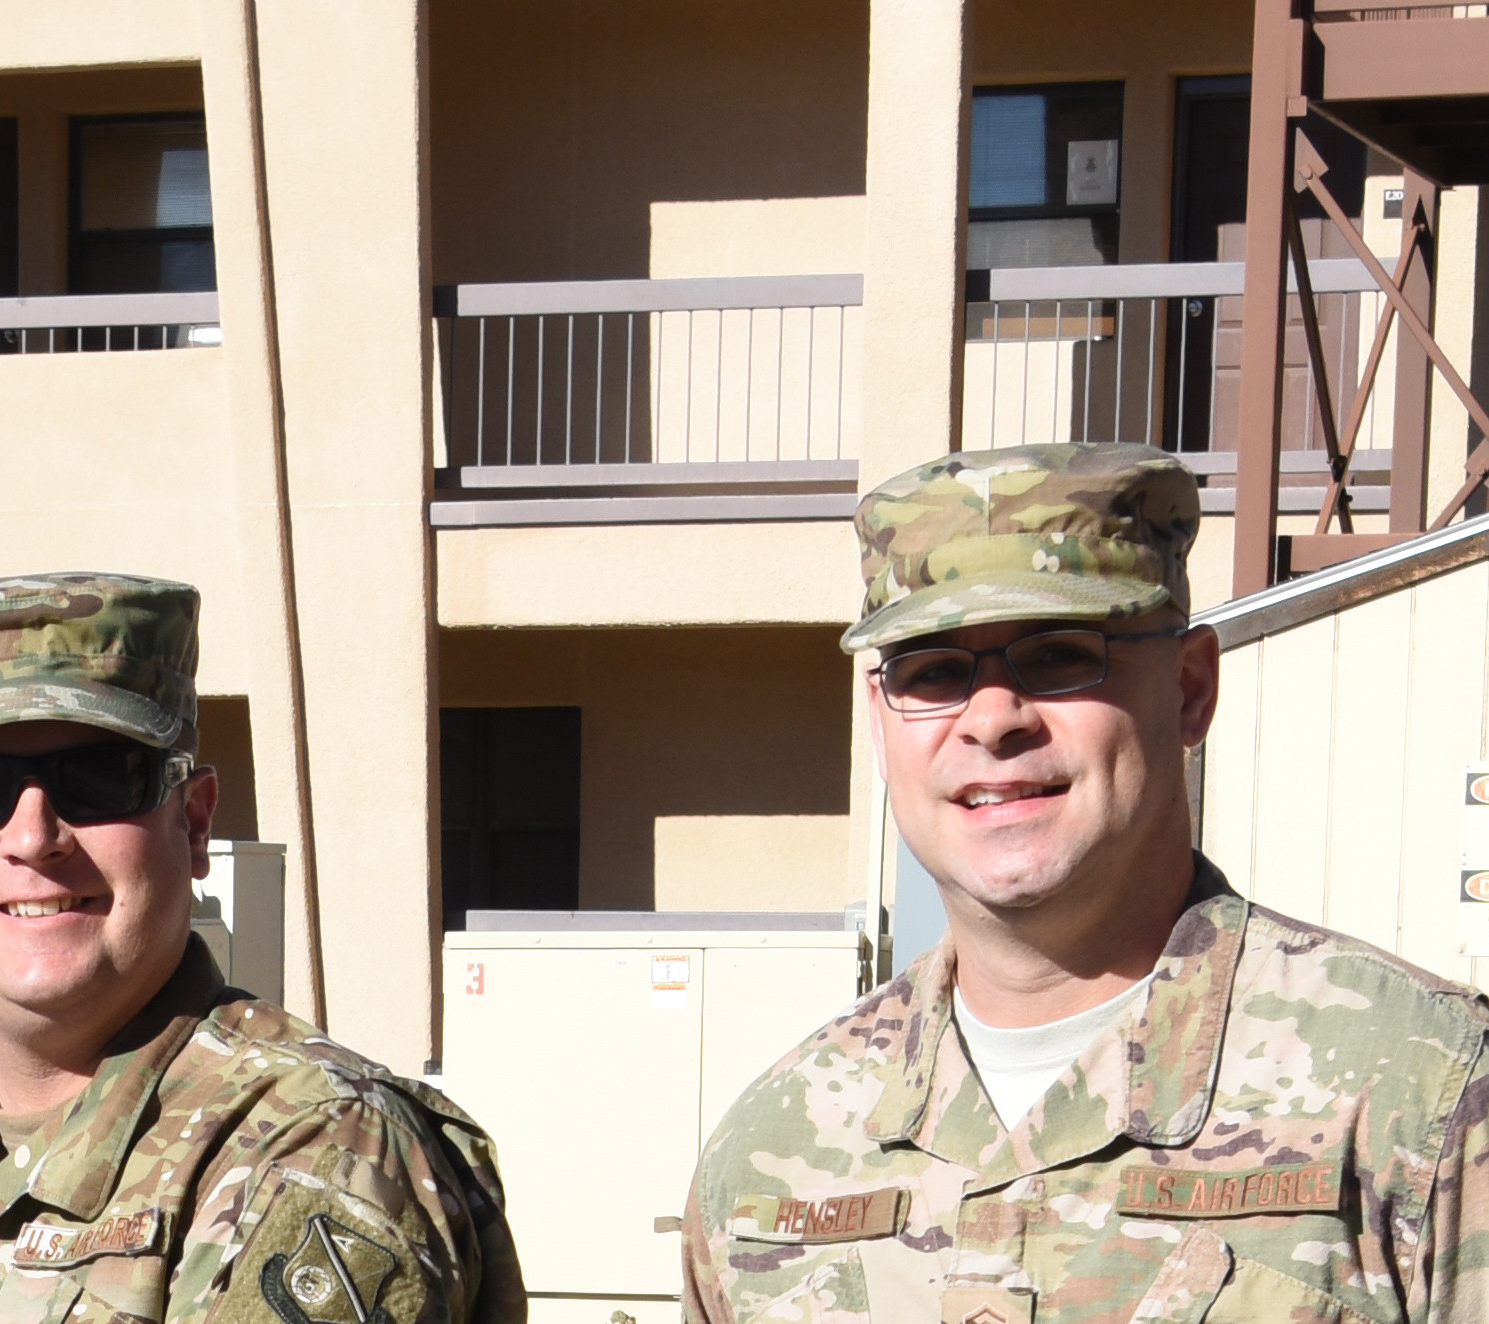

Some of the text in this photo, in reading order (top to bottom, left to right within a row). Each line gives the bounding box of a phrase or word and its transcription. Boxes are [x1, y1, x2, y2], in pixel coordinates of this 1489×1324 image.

[466, 963, 484, 995] 3
[1126, 1167, 1334, 1213] U.S. AIR FORCE
[24, 1211, 151, 1261] U.S. AIR FORCE
[774, 1195, 873, 1235] HENSLEY
